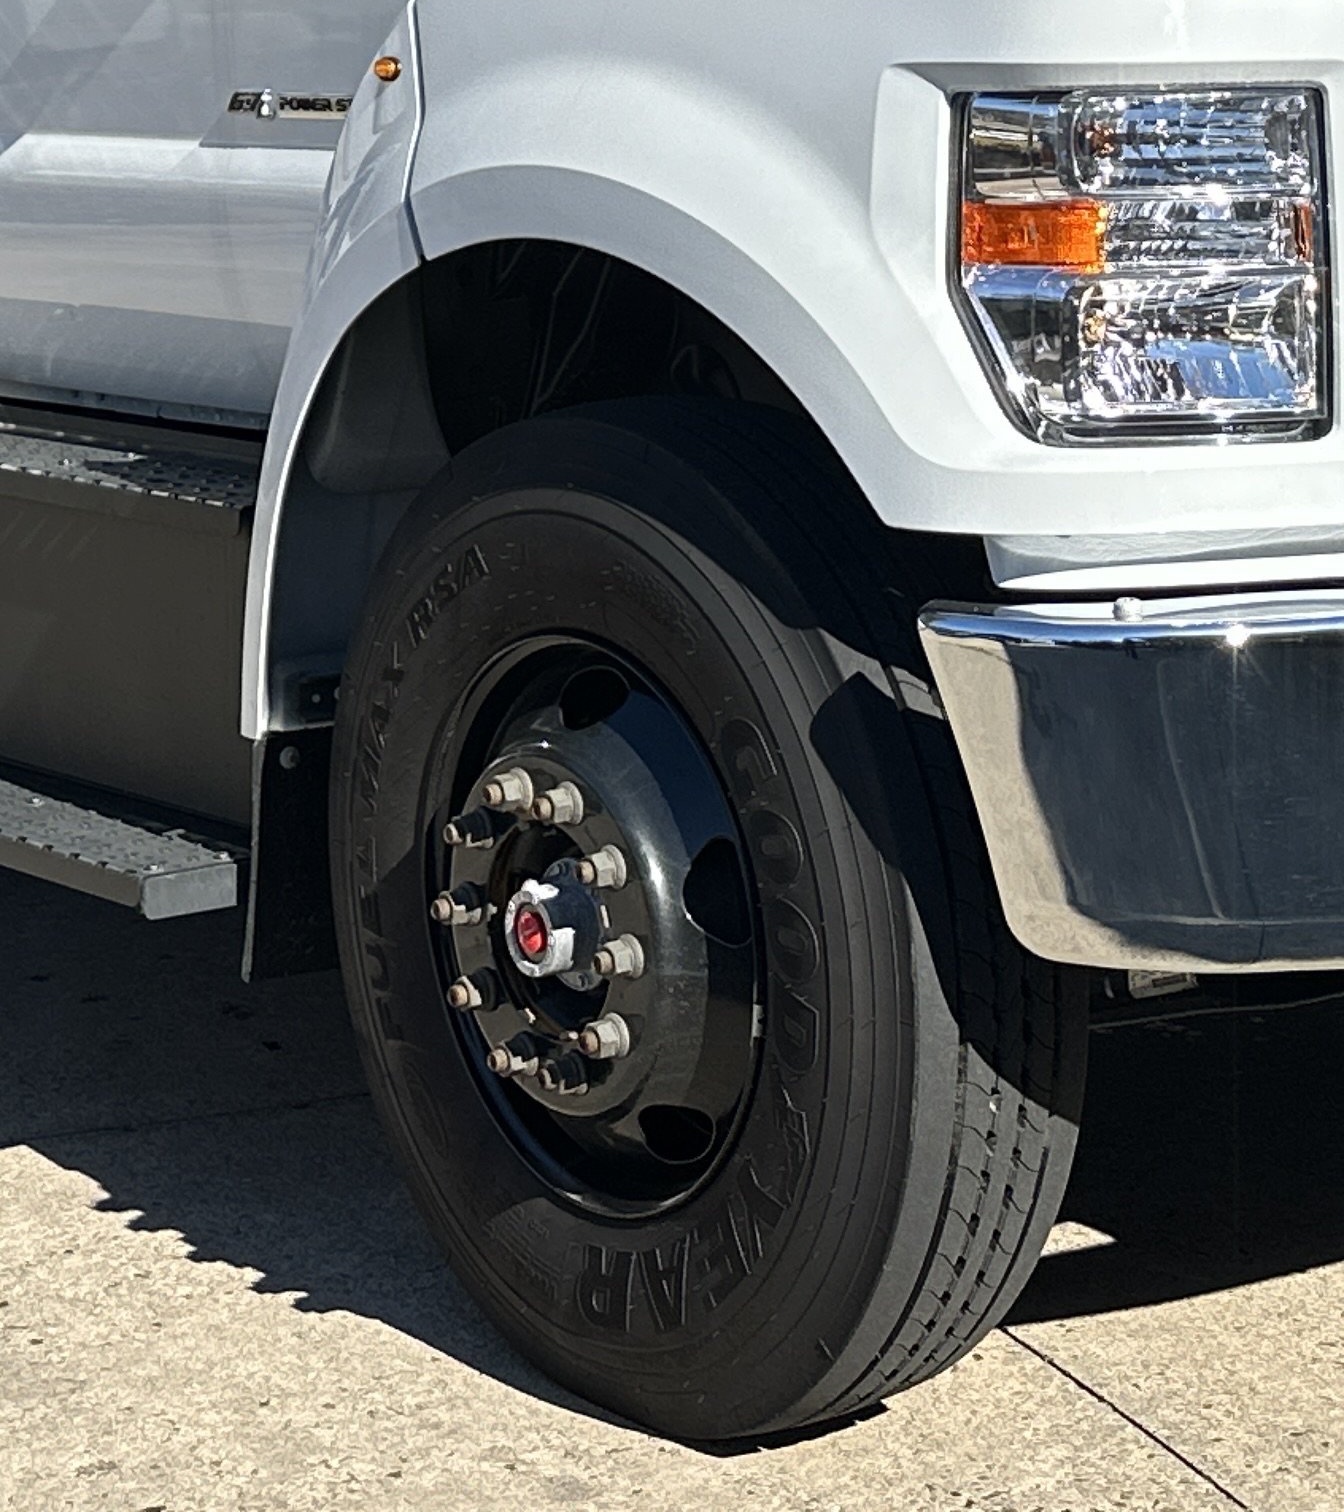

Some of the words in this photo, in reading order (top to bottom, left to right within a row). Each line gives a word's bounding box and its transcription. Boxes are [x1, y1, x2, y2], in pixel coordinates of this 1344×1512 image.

[278, 96, 333, 112] POWER
[404, 543, 491, 649] RSA
[576, 716, 823, 1331] GOODYEAR
